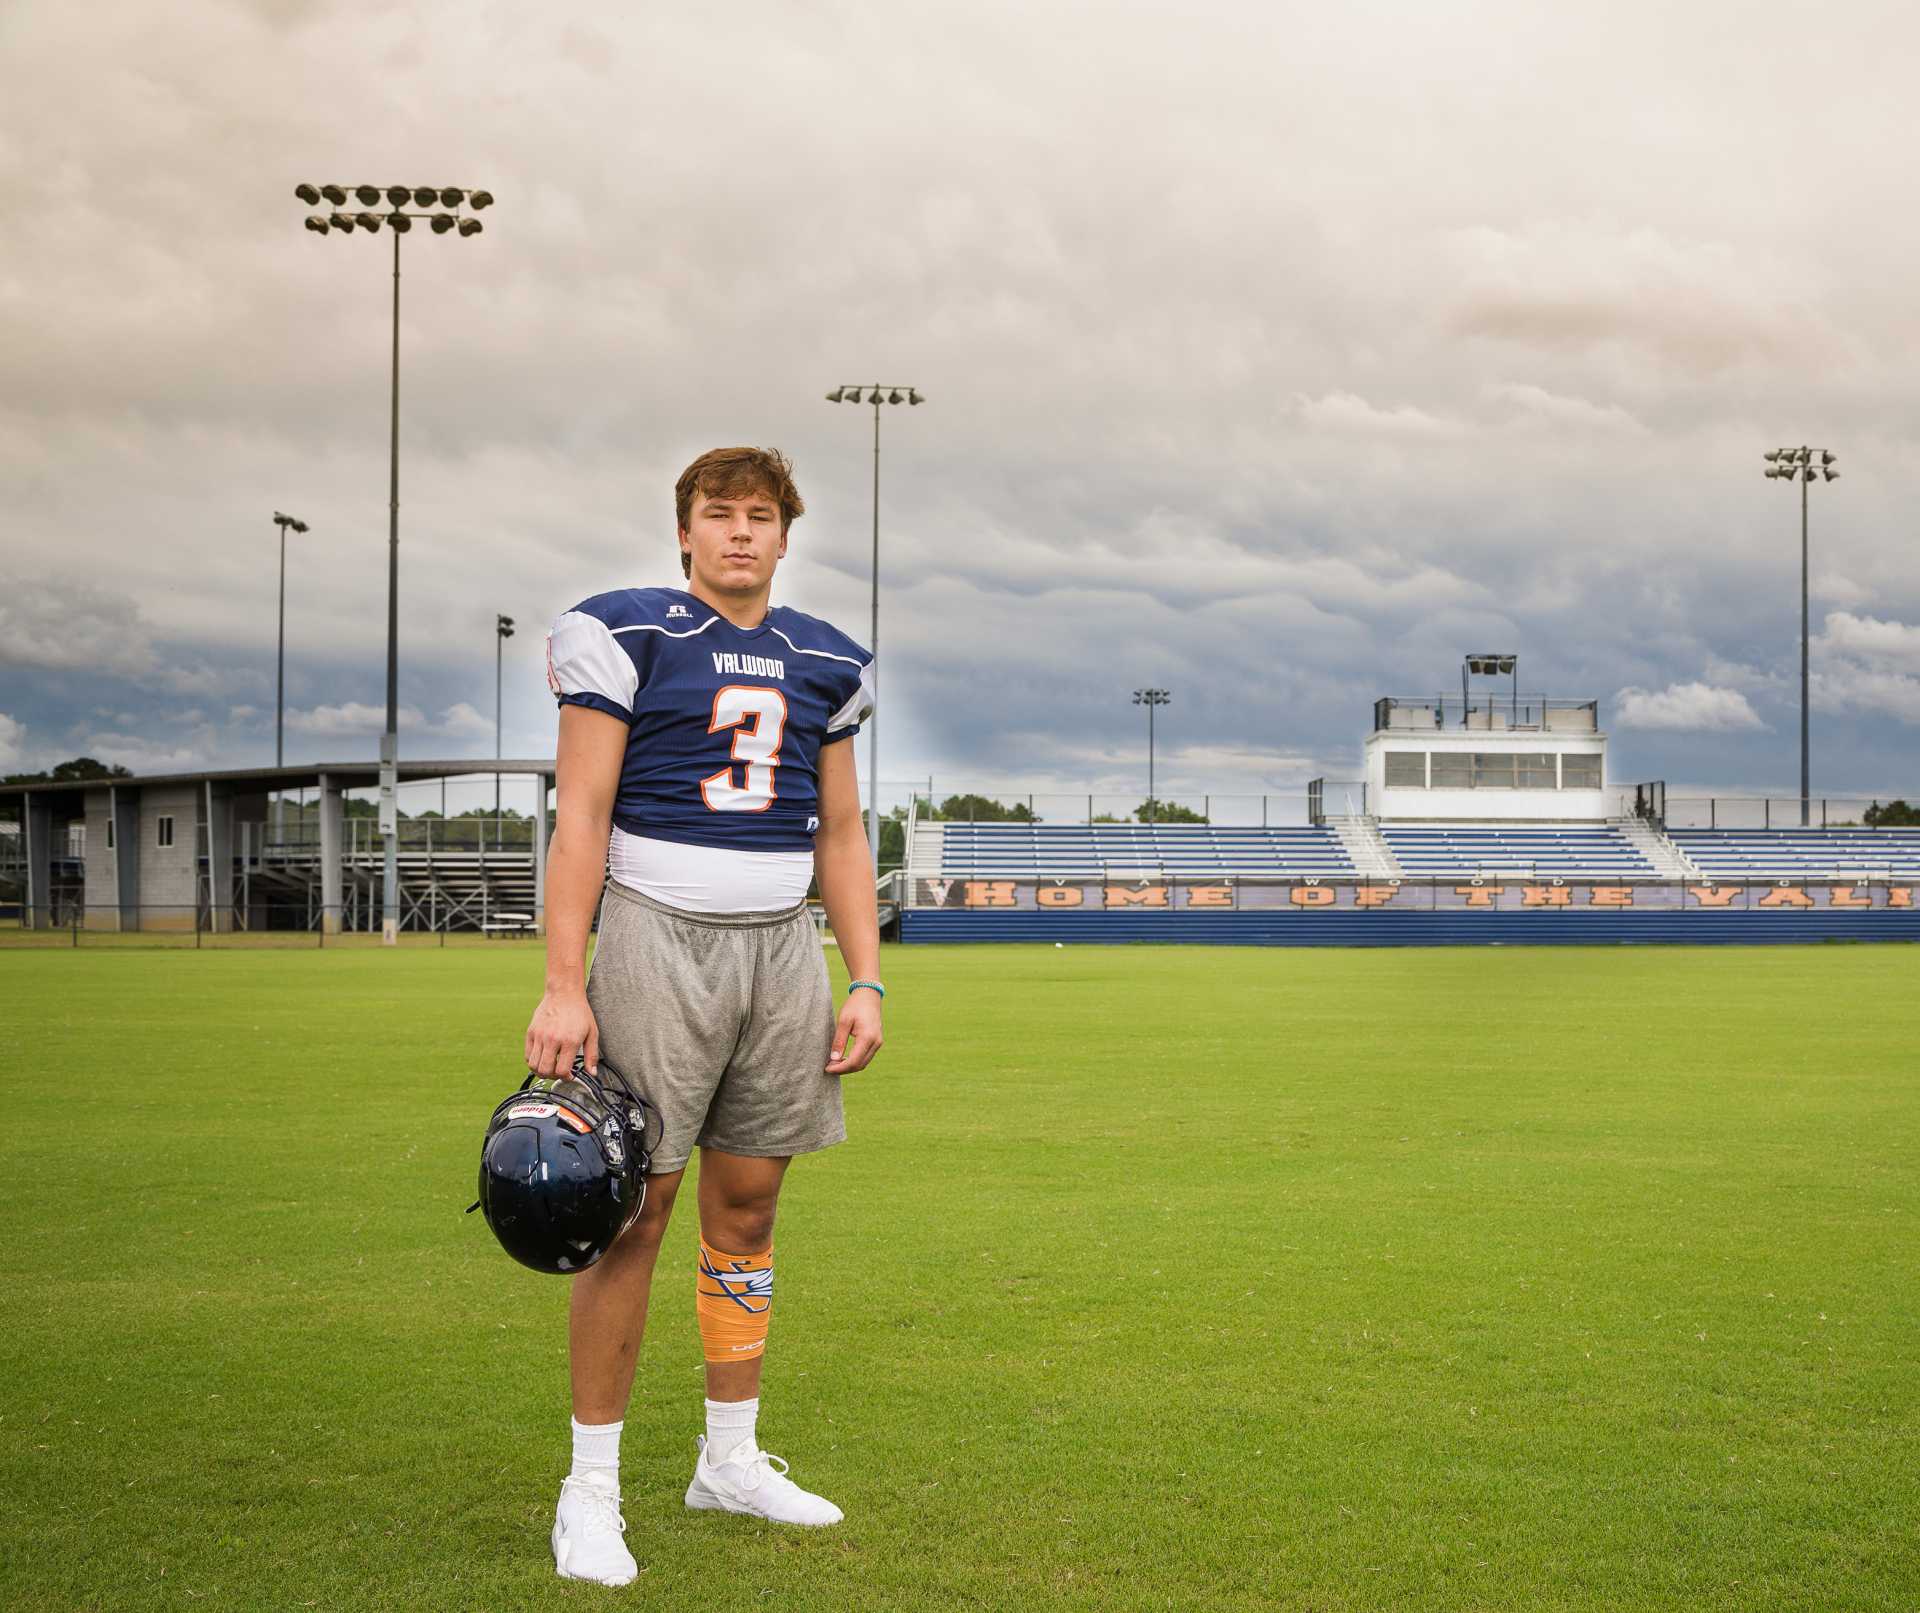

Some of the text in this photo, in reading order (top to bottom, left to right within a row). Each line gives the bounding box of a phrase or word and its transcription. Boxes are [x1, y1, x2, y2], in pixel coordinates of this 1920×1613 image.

[712, 652, 784, 680] VALWOOD
[700, 684, 787, 812] 3
[964, 881, 1233, 907] HOME
[1290, 886, 1399, 907] OF
[1455, 886, 1634, 906] THE
